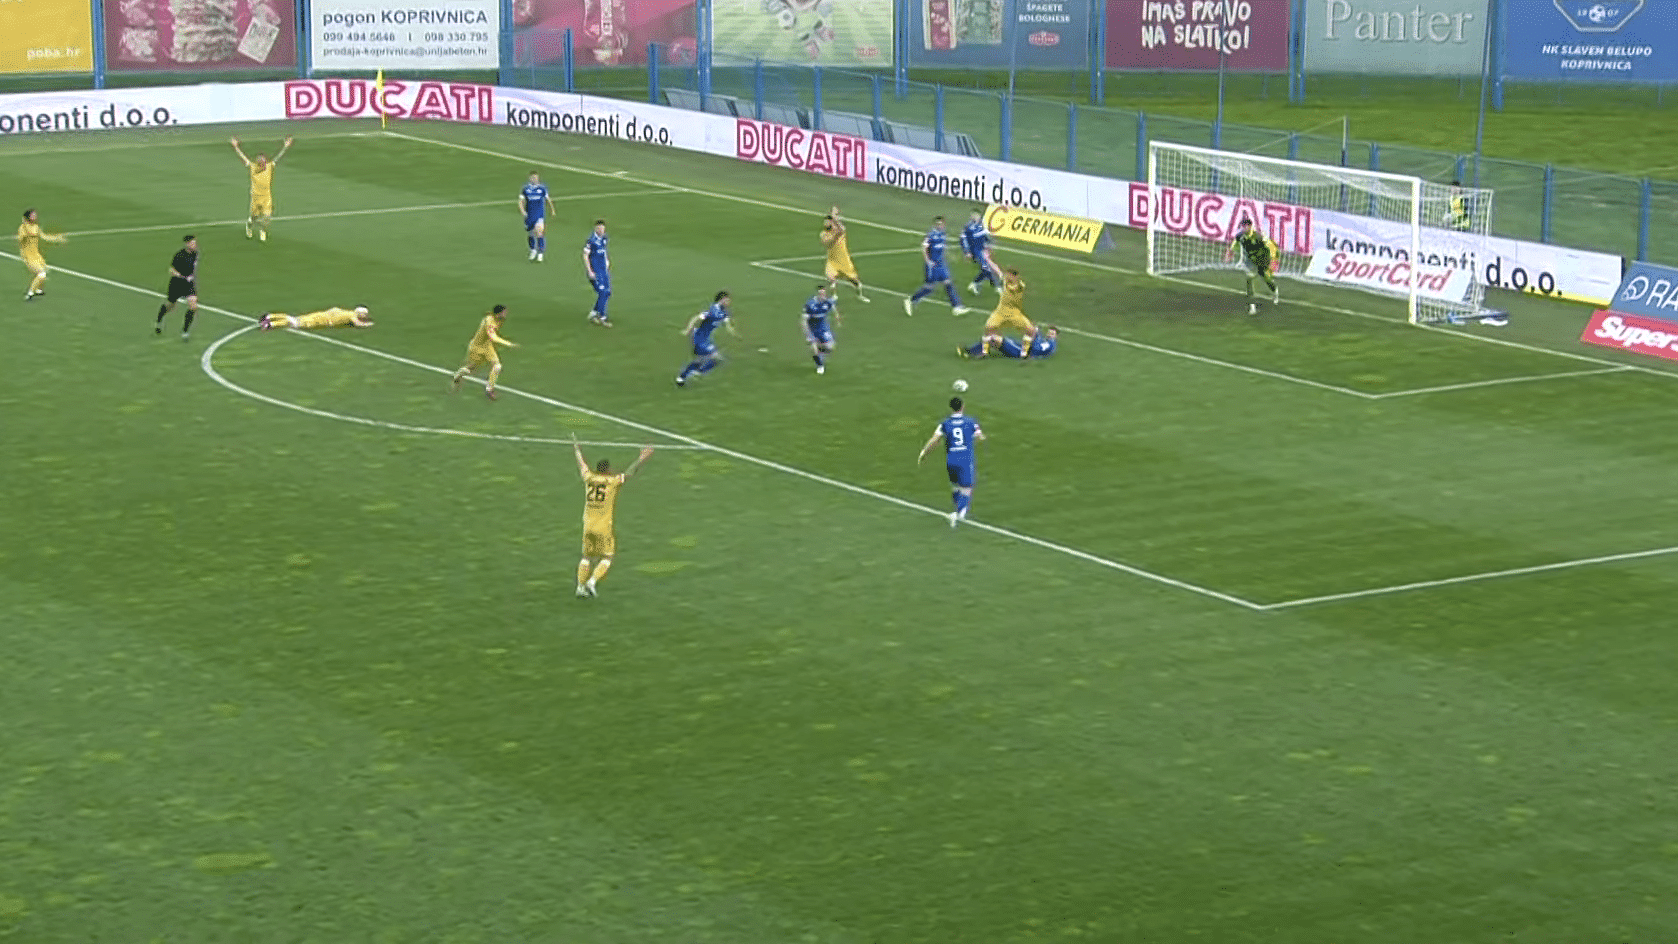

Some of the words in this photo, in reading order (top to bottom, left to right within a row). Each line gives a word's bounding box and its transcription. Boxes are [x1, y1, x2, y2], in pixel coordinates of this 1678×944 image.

[323, 12, 375, 28] pogon
[381, 9, 488, 24] KOPRIVNICA
[1192, 0, 1252, 27] PRAVO
[1323, 0, 1474, 43] Panter
[1141, 25, 1167, 49] NA
[1560, 45, 1604, 55] SLAVEN
[284, 81, 494, 122] DUCATI
[0, 105, 89, 133] onenti
[99, 103, 178, 129] d.o.o.
[506, 101, 620, 139] komponenti
[626, 117, 673, 145] d.o.o.
[737, 117, 868, 182] DUCATI
[876, 158, 985, 202] komponenti
[991, 178, 1047, 212] d.o.o.
[1010, 215, 1091, 244] GERMANIA
[1128, 182, 1313, 254] DUCATI
[1485, 256, 1563, 296] d.o.o.
[952, 427, 964, 446] 9
[586, 483, 606, 502] 26
